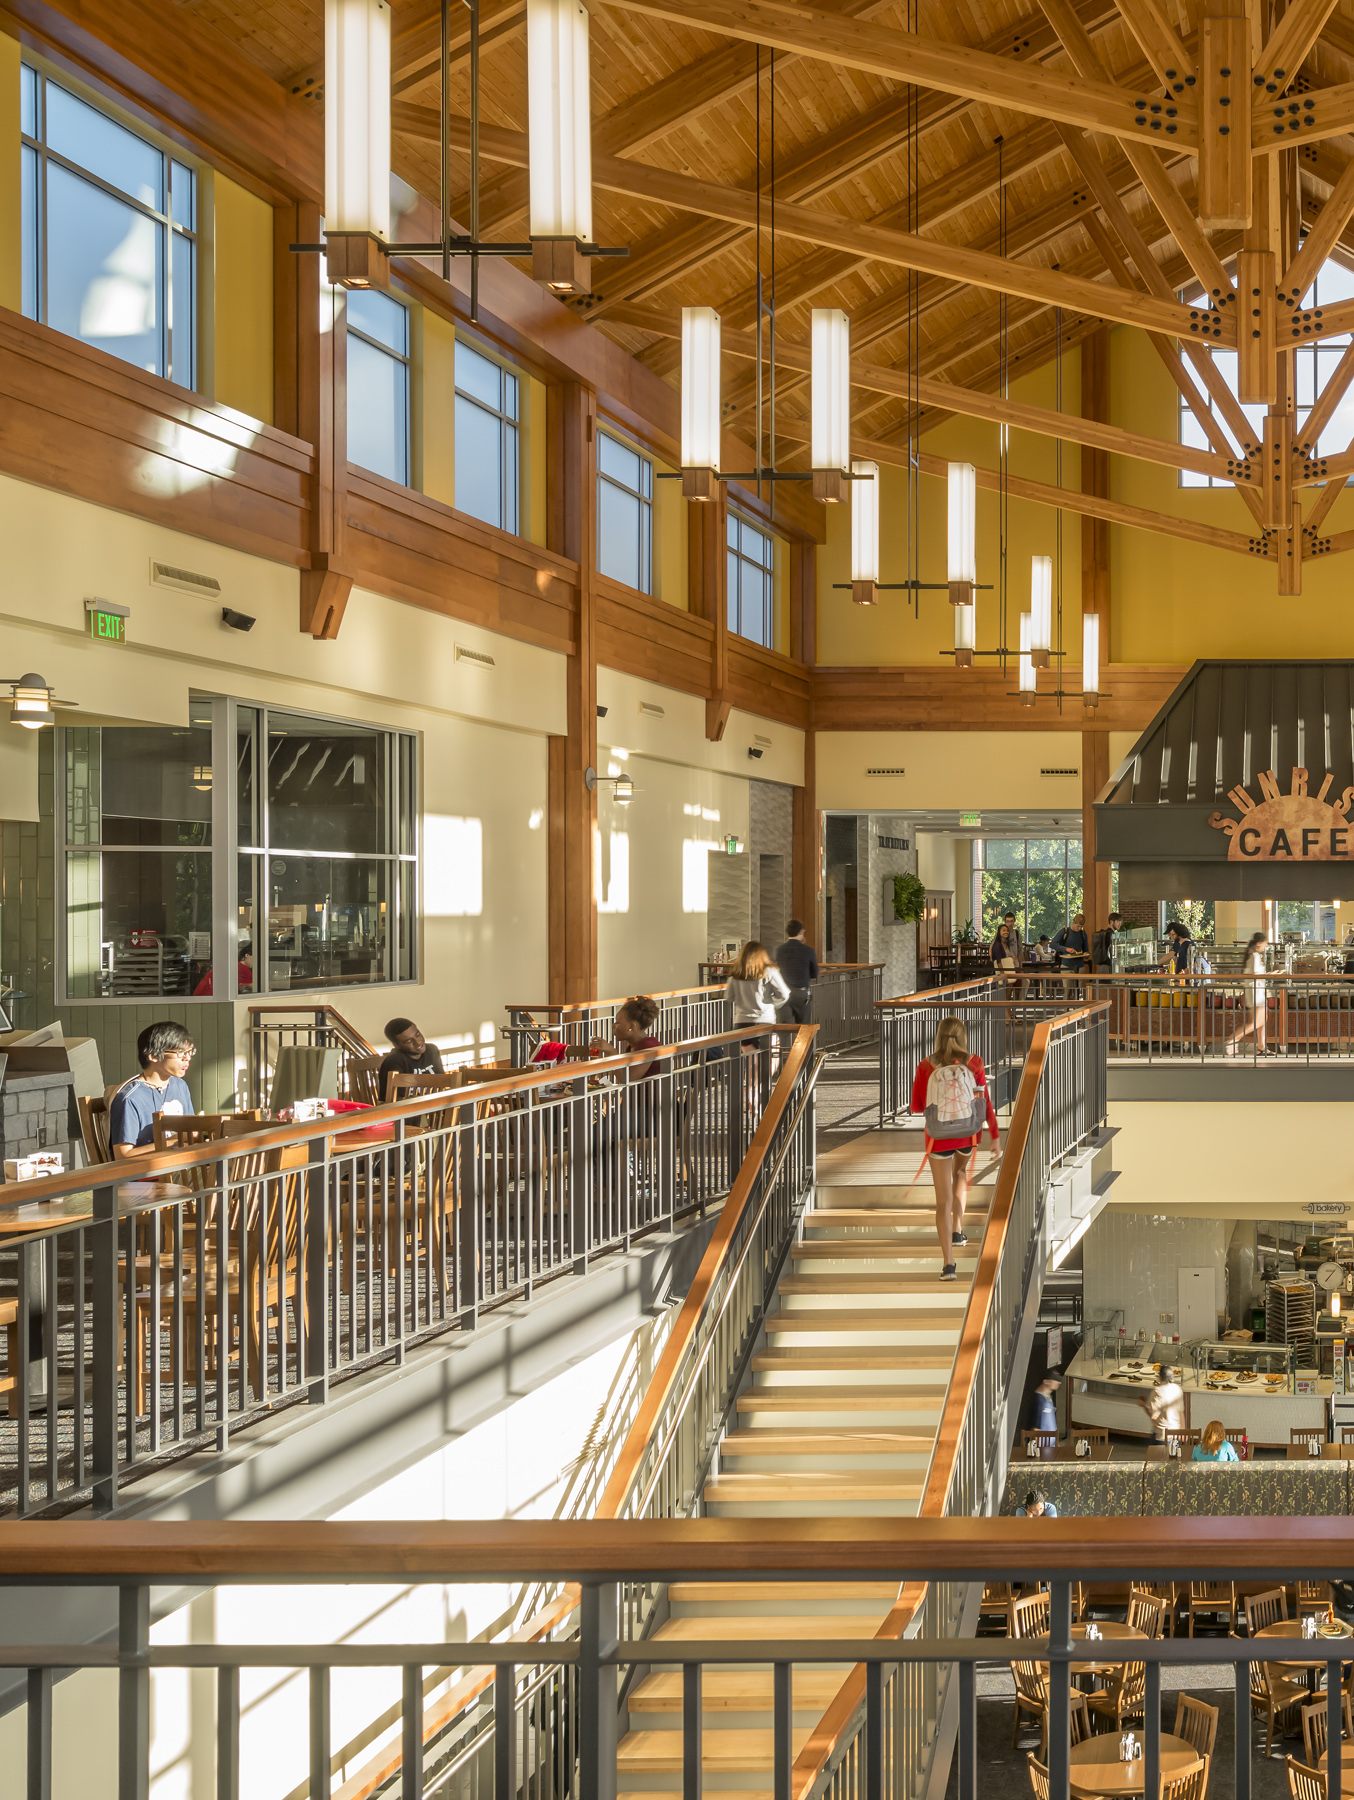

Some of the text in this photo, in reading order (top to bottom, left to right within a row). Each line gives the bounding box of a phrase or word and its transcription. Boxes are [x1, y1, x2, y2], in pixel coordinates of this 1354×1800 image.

[98, 613, 120, 639] EXIT
[963, 814, 978, 825] EXIT
[1239, 828, 1348, 856] CAFE
[1316, 1204, 1342, 1212] bakery
